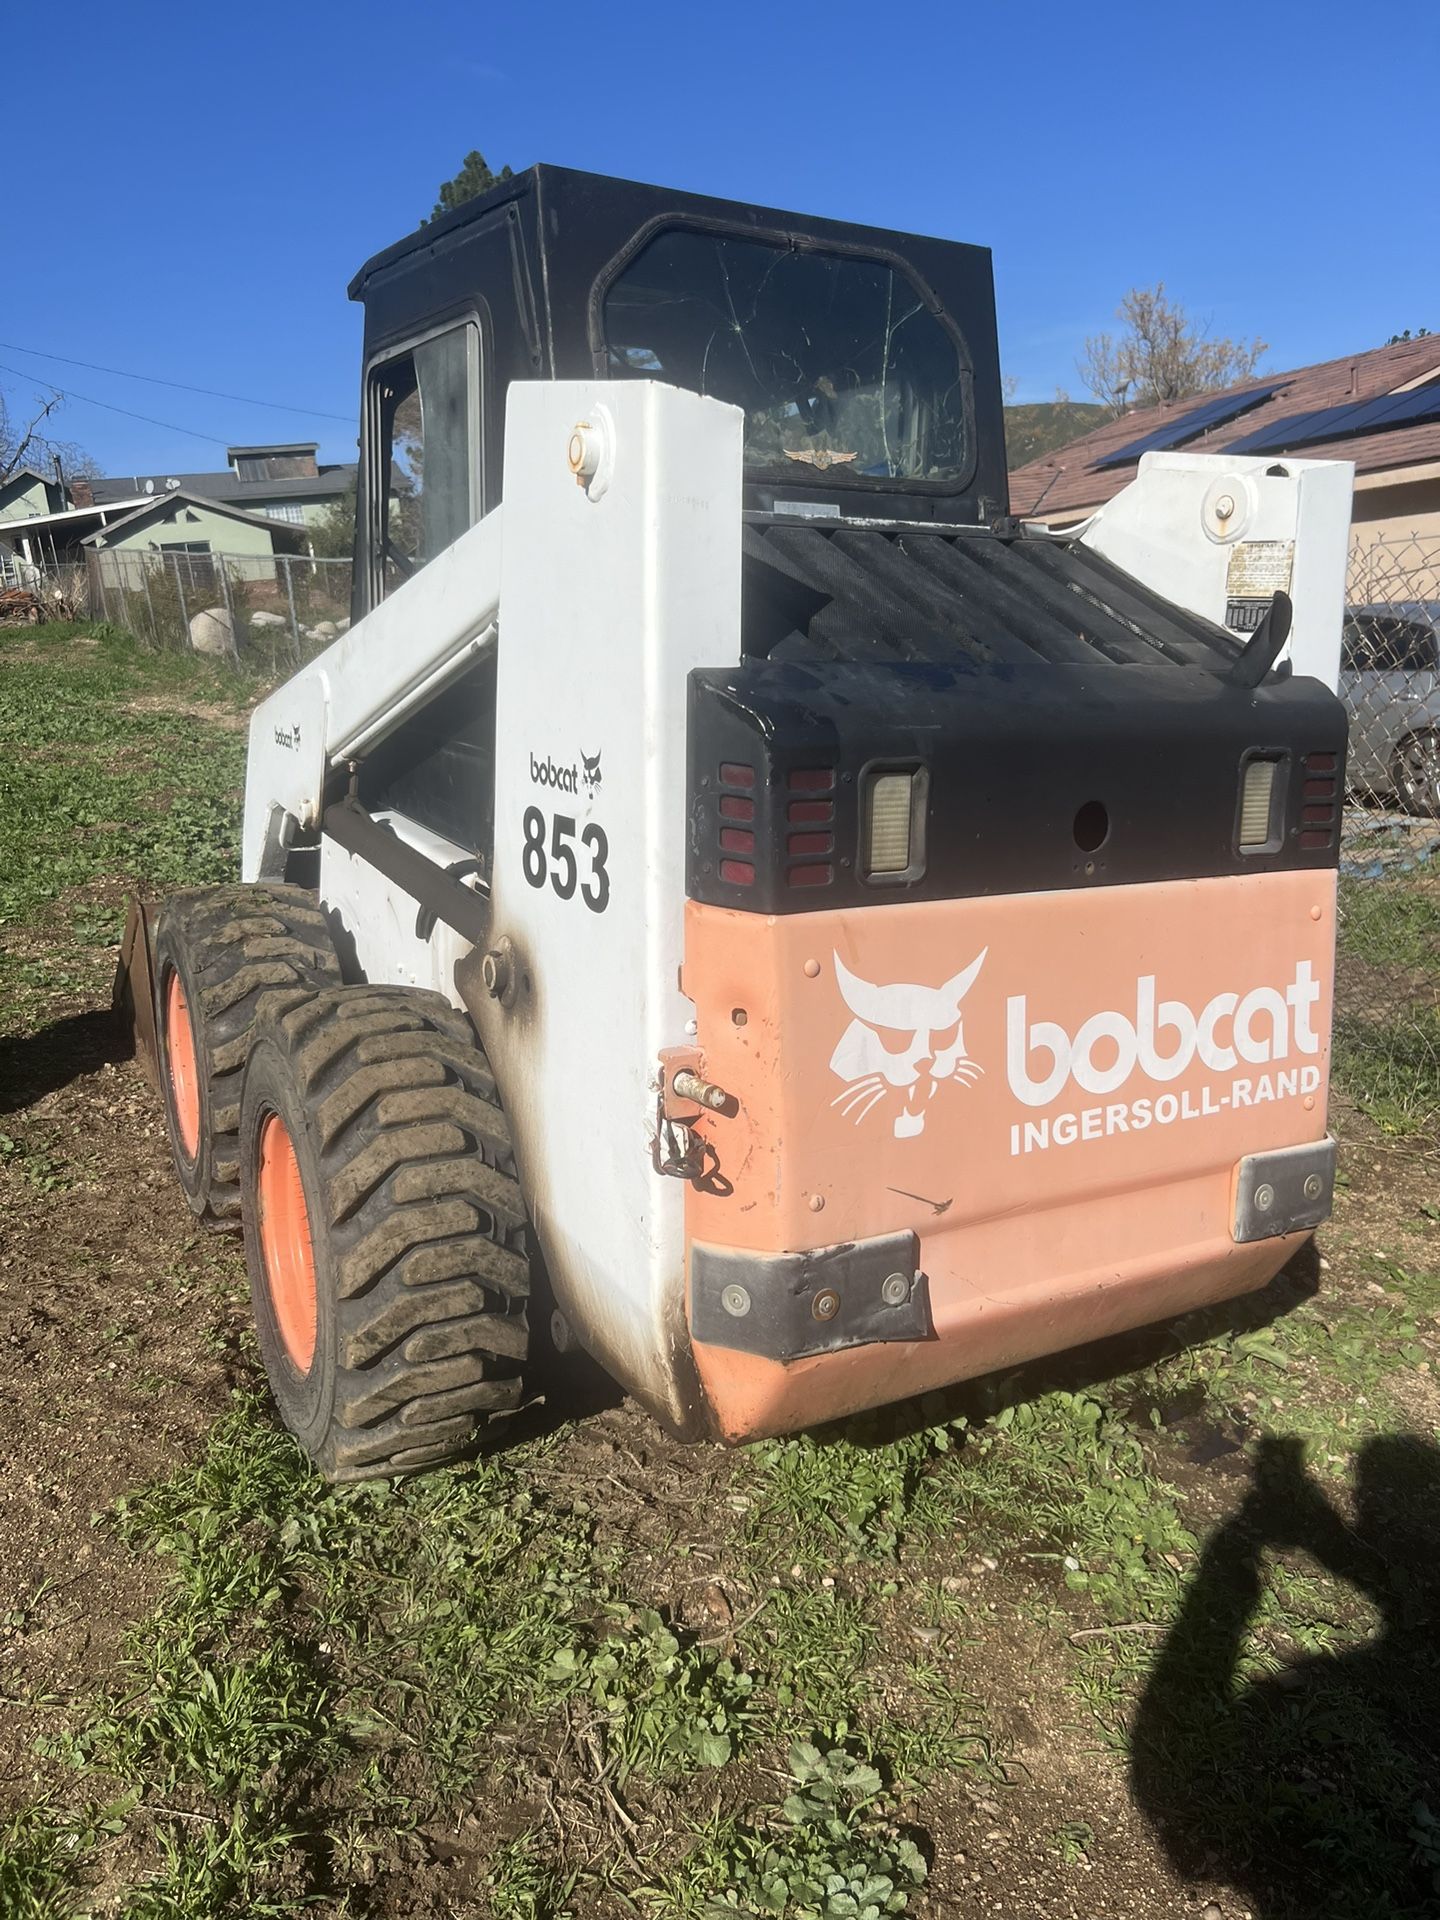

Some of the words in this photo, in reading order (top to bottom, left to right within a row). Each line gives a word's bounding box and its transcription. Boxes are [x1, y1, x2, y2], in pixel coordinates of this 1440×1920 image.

[530, 751, 578, 795] bobcat
[522, 805, 610, 914] 853
[1006, 960, 1320, 1107] bobcat
[1010, 1065, 1321, 1156] INGERSOLL-RAND
